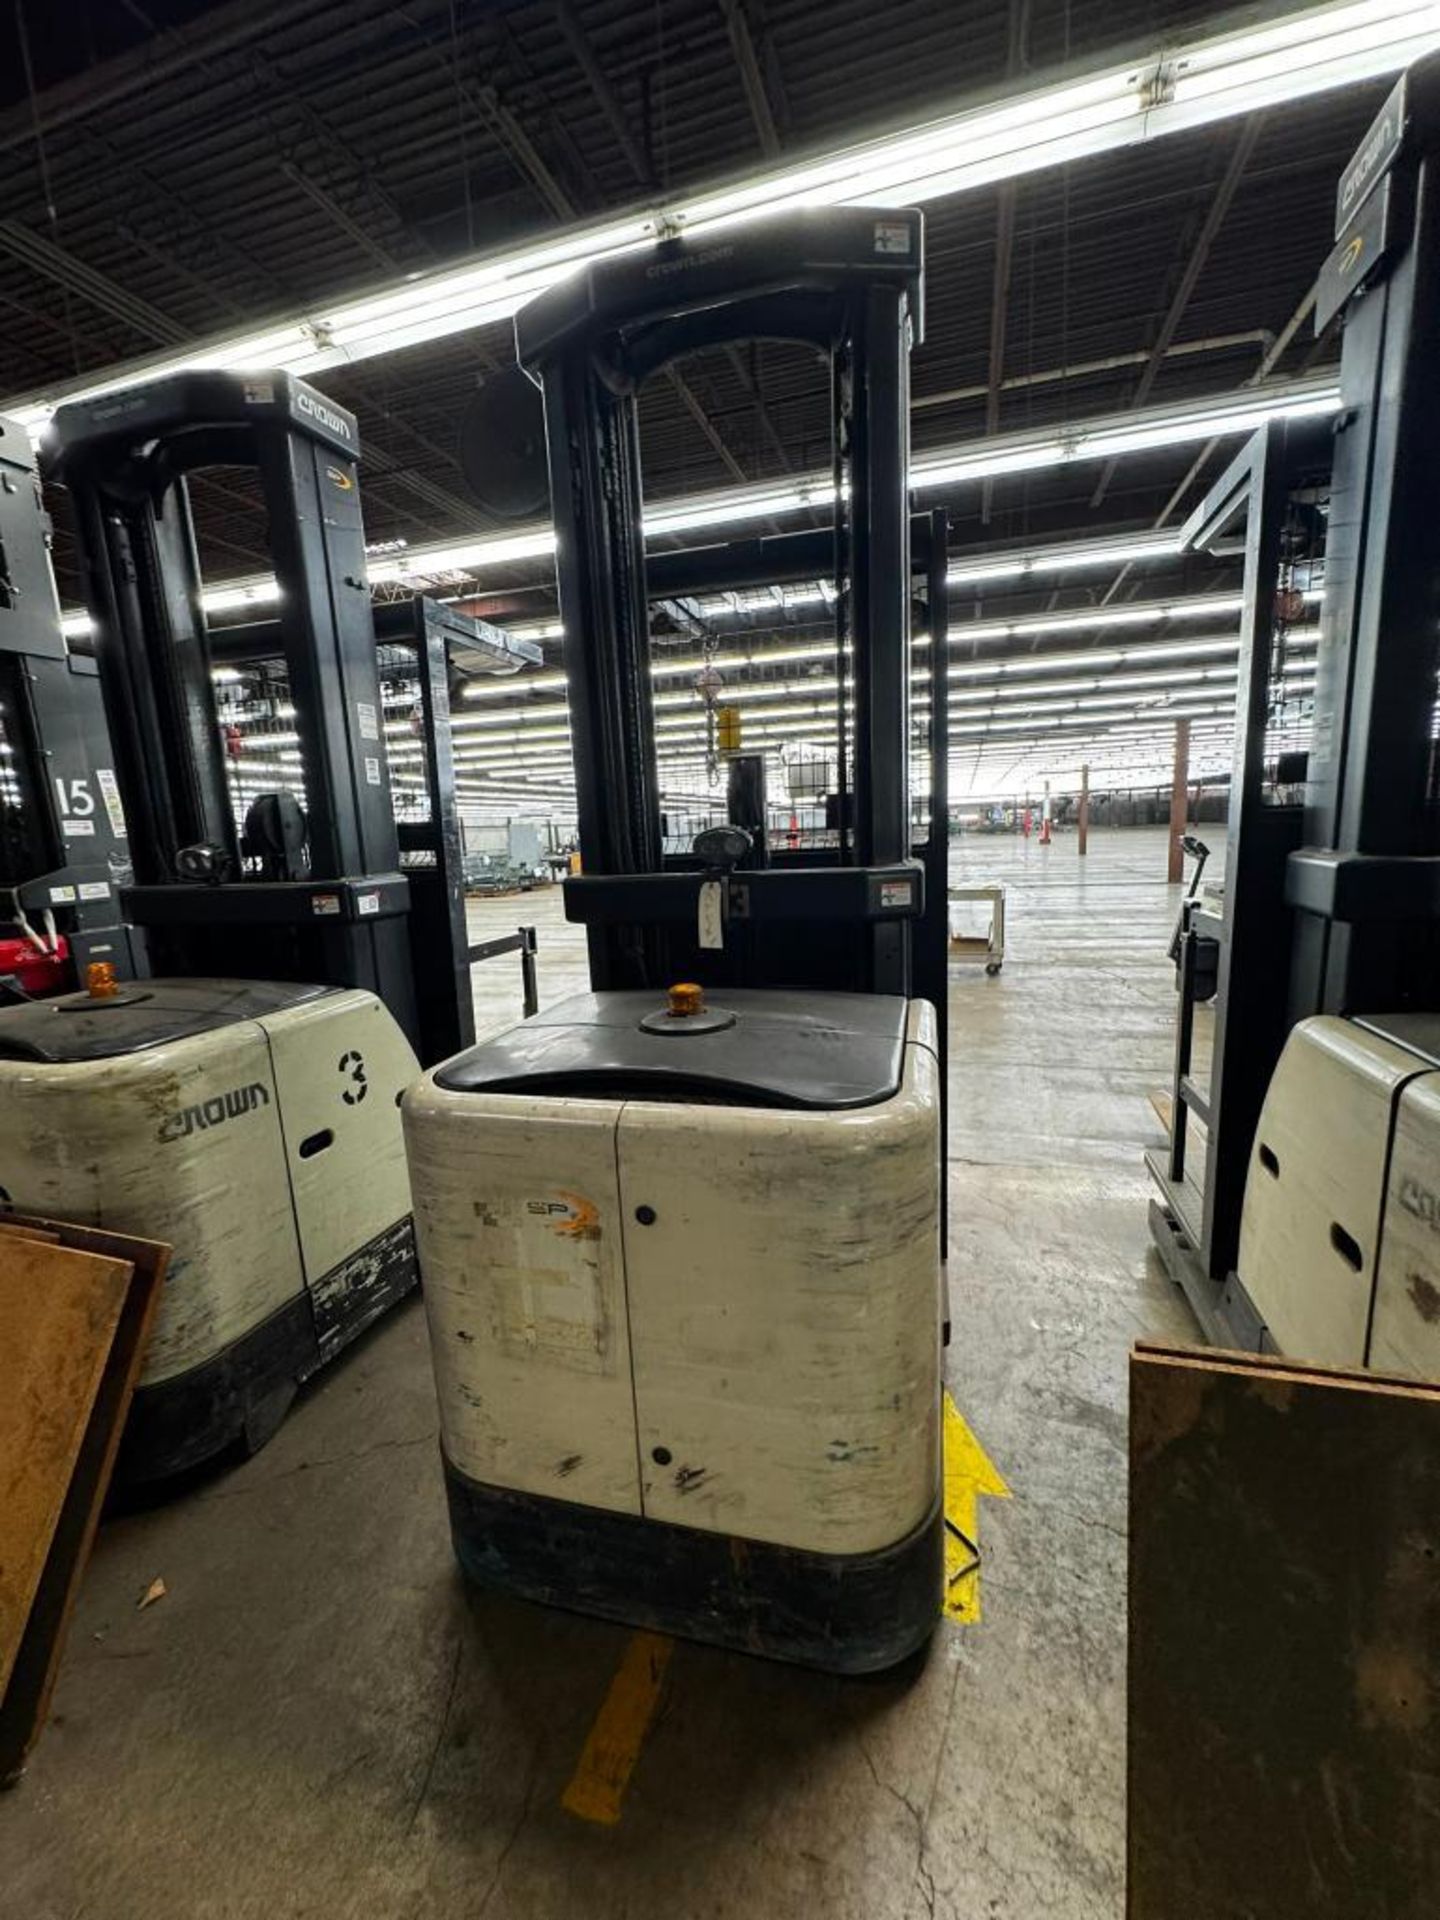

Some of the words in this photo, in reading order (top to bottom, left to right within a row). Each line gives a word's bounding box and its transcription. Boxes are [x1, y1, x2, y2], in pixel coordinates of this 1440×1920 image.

[296, 393, 351, 440] CROWN
[56, 777, 95, 816] 15
[337, 1050, 369, 1106] 3
[158, 1081, 270, 1143] CROWN
